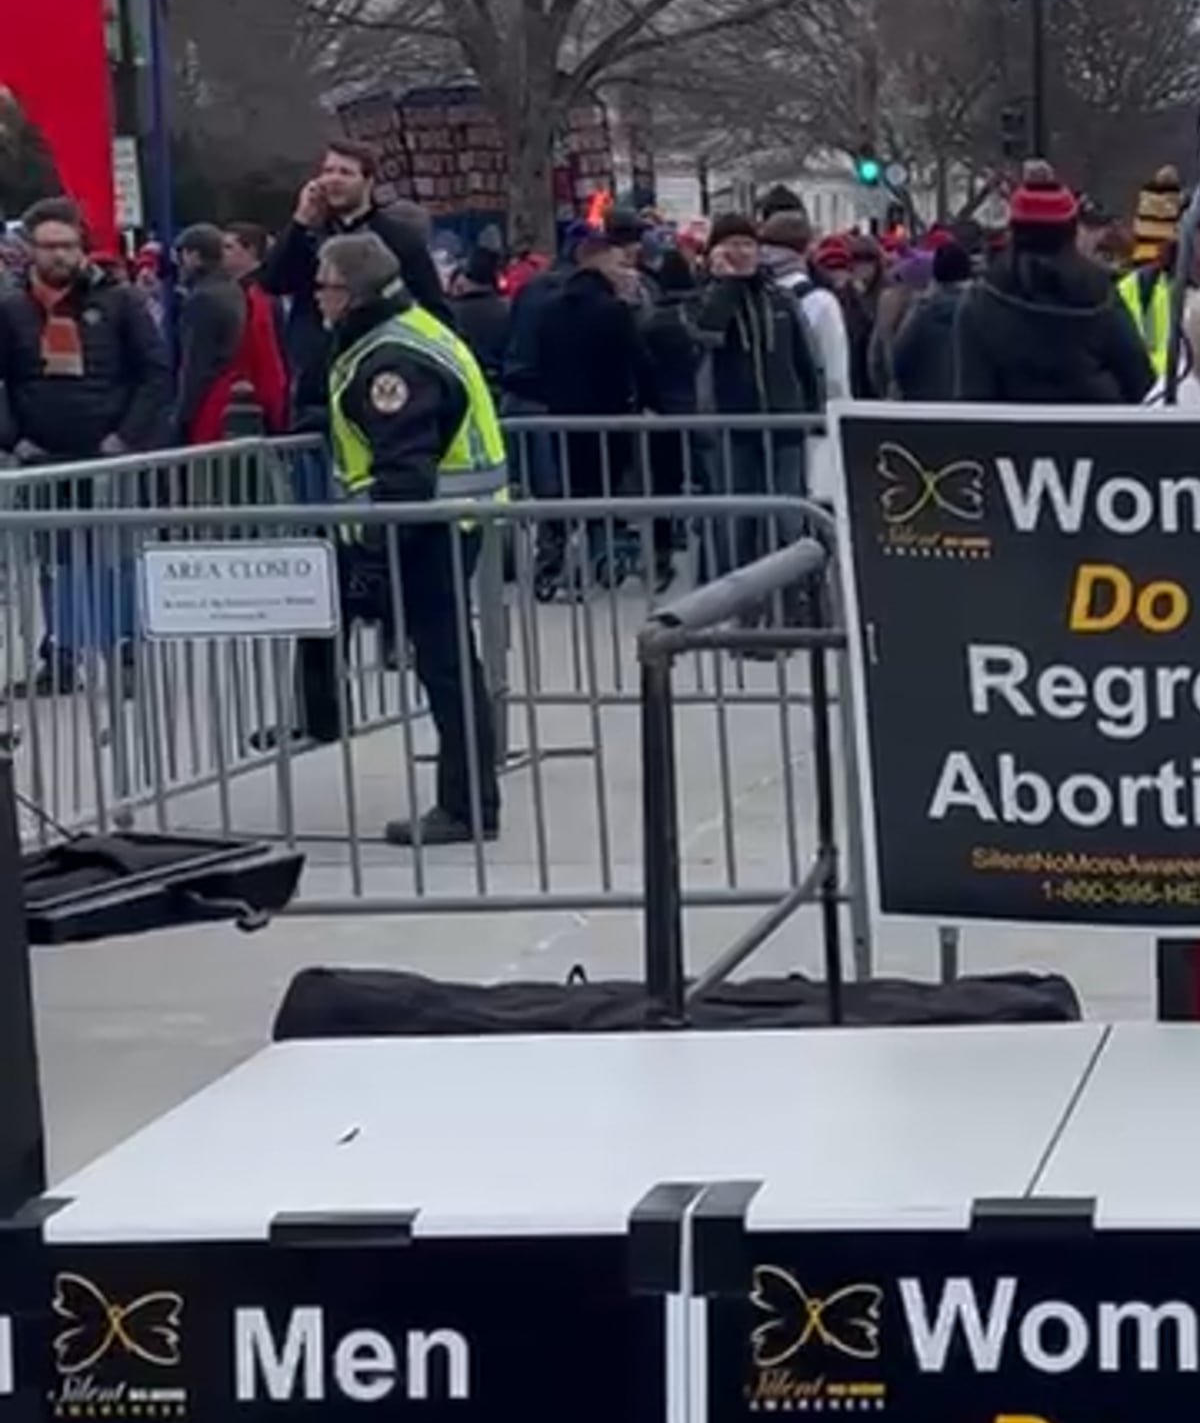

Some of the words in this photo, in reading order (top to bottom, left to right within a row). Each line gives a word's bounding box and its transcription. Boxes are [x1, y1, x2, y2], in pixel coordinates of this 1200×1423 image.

[164, 561, 223, 579] AREA
[229, 558, 312, 578] CLOSED
[1070, 564, 1188, 631] Do
[235, 1306, 469, 1401] Men
